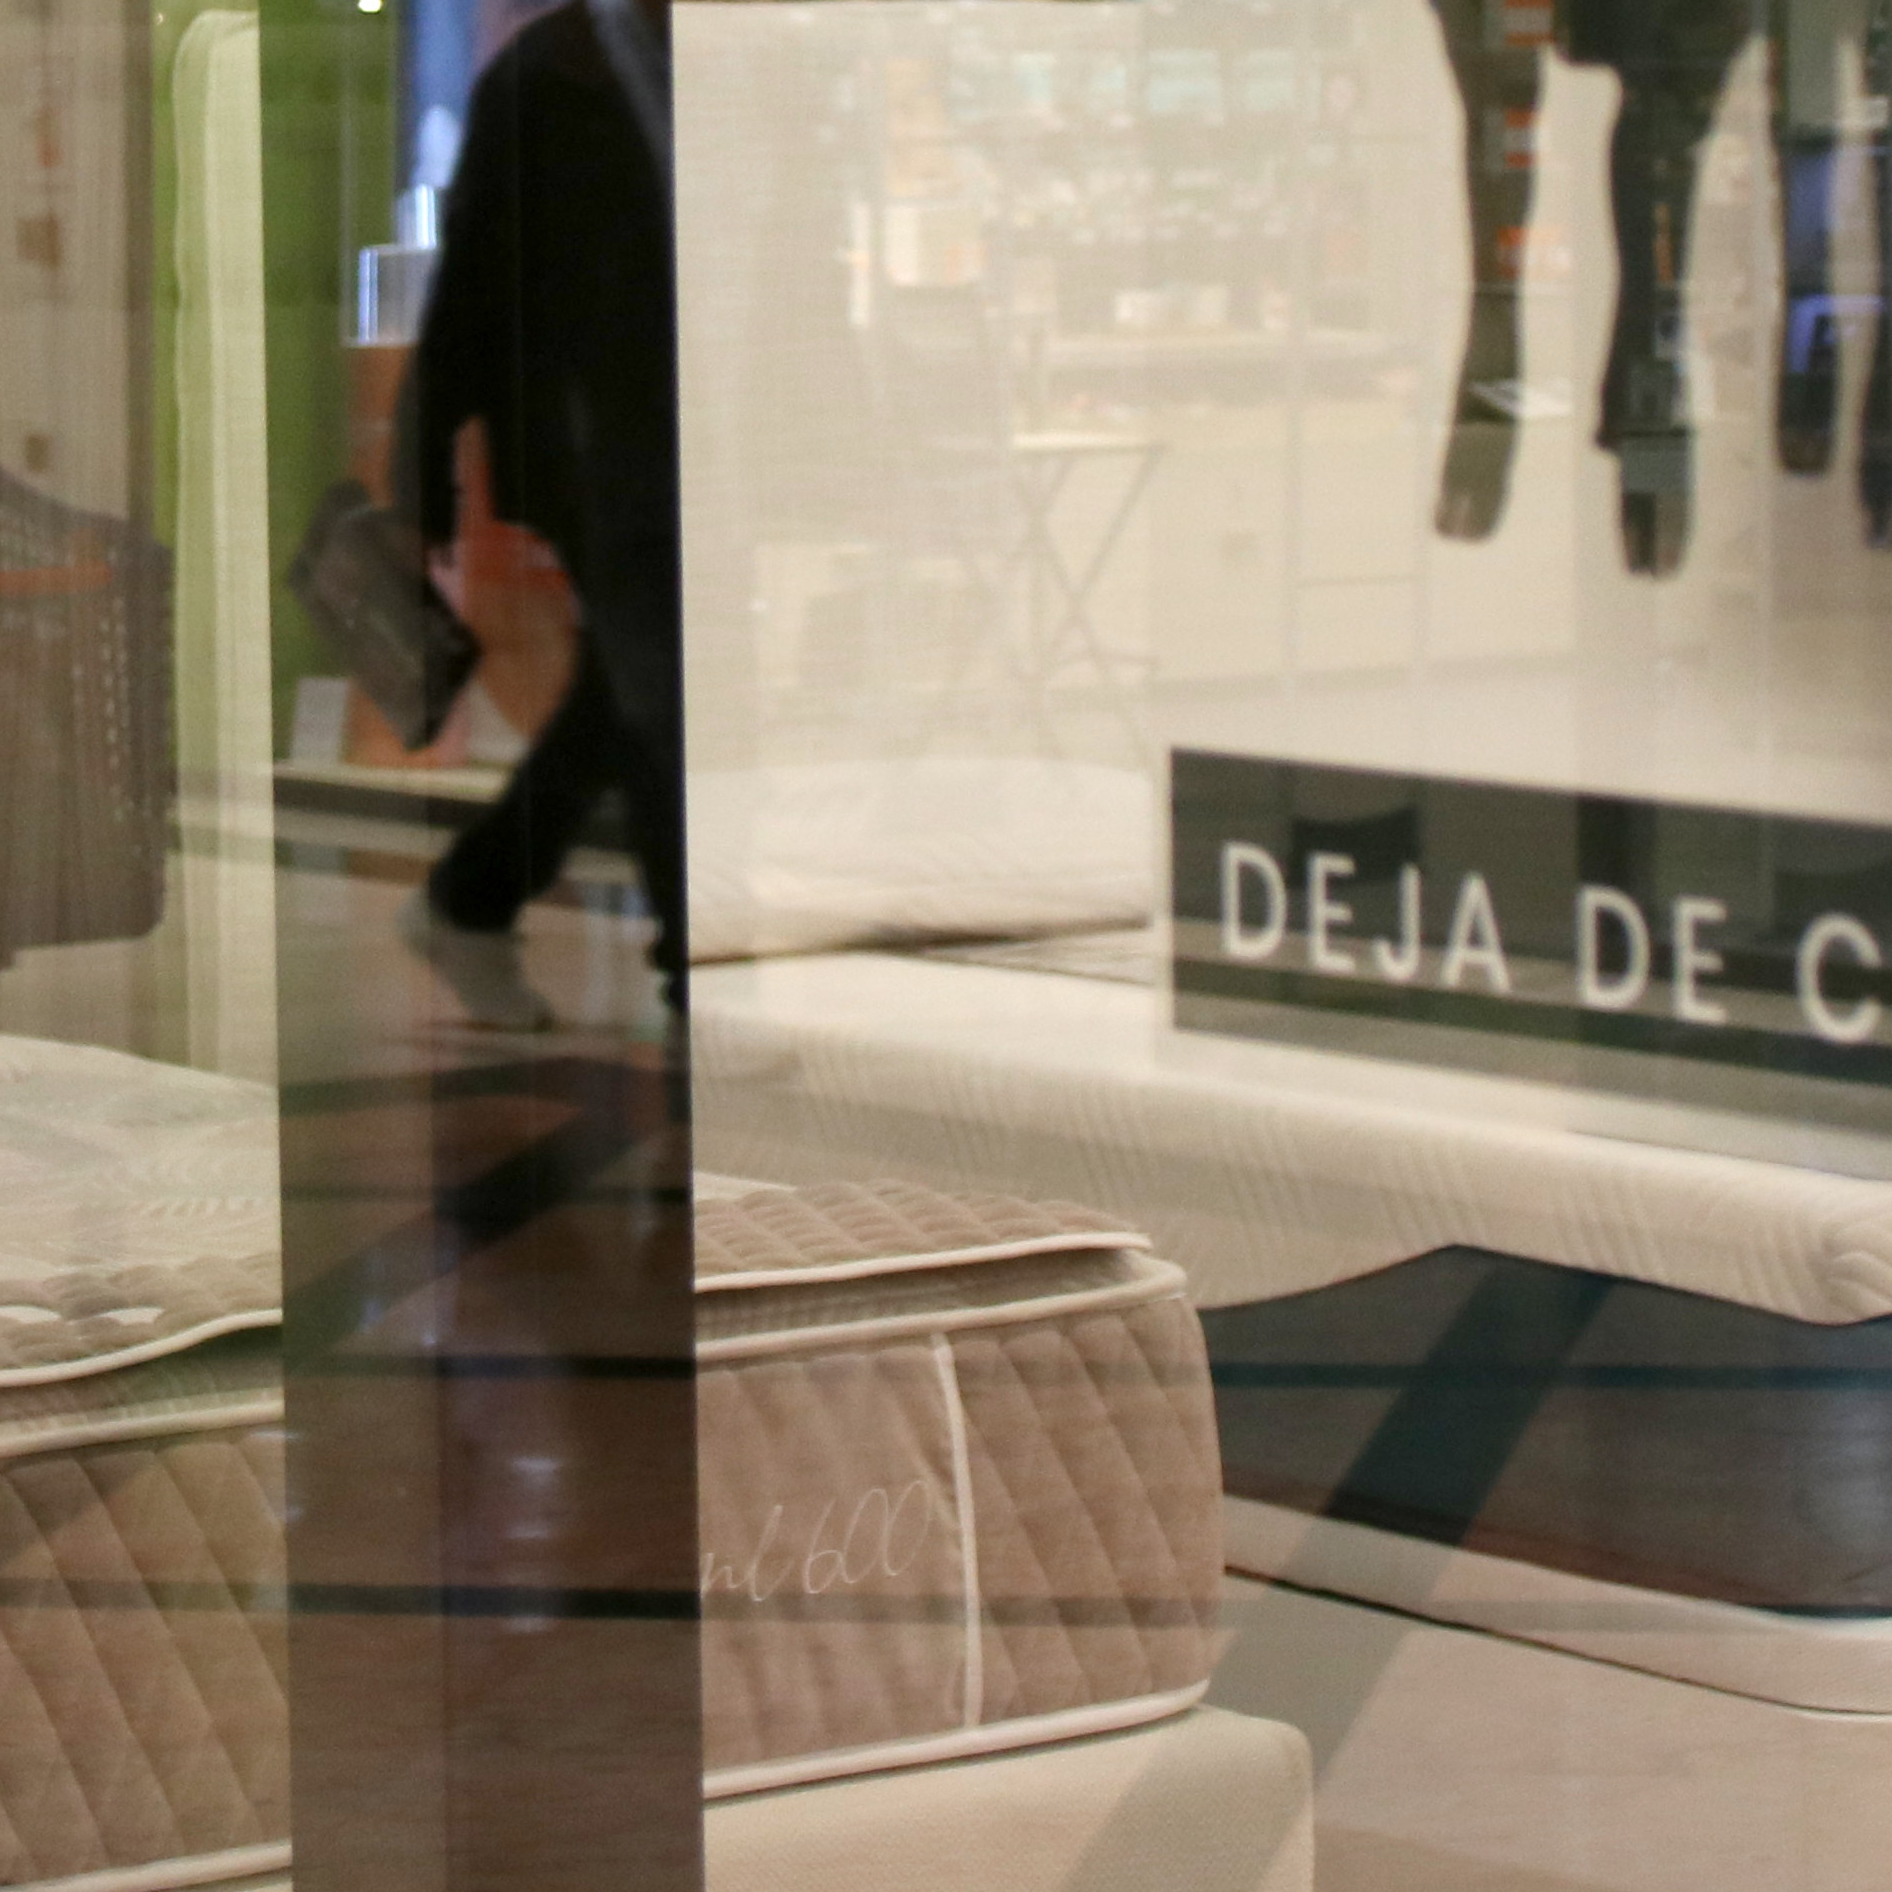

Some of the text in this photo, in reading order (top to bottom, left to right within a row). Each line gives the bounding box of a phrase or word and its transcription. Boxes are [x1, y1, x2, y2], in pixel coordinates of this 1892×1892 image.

[1220, 841, 1510, 991] DEJA
[1576, 884, 1730, 1024] DE
[805, 1479, 932, 1594] 600
